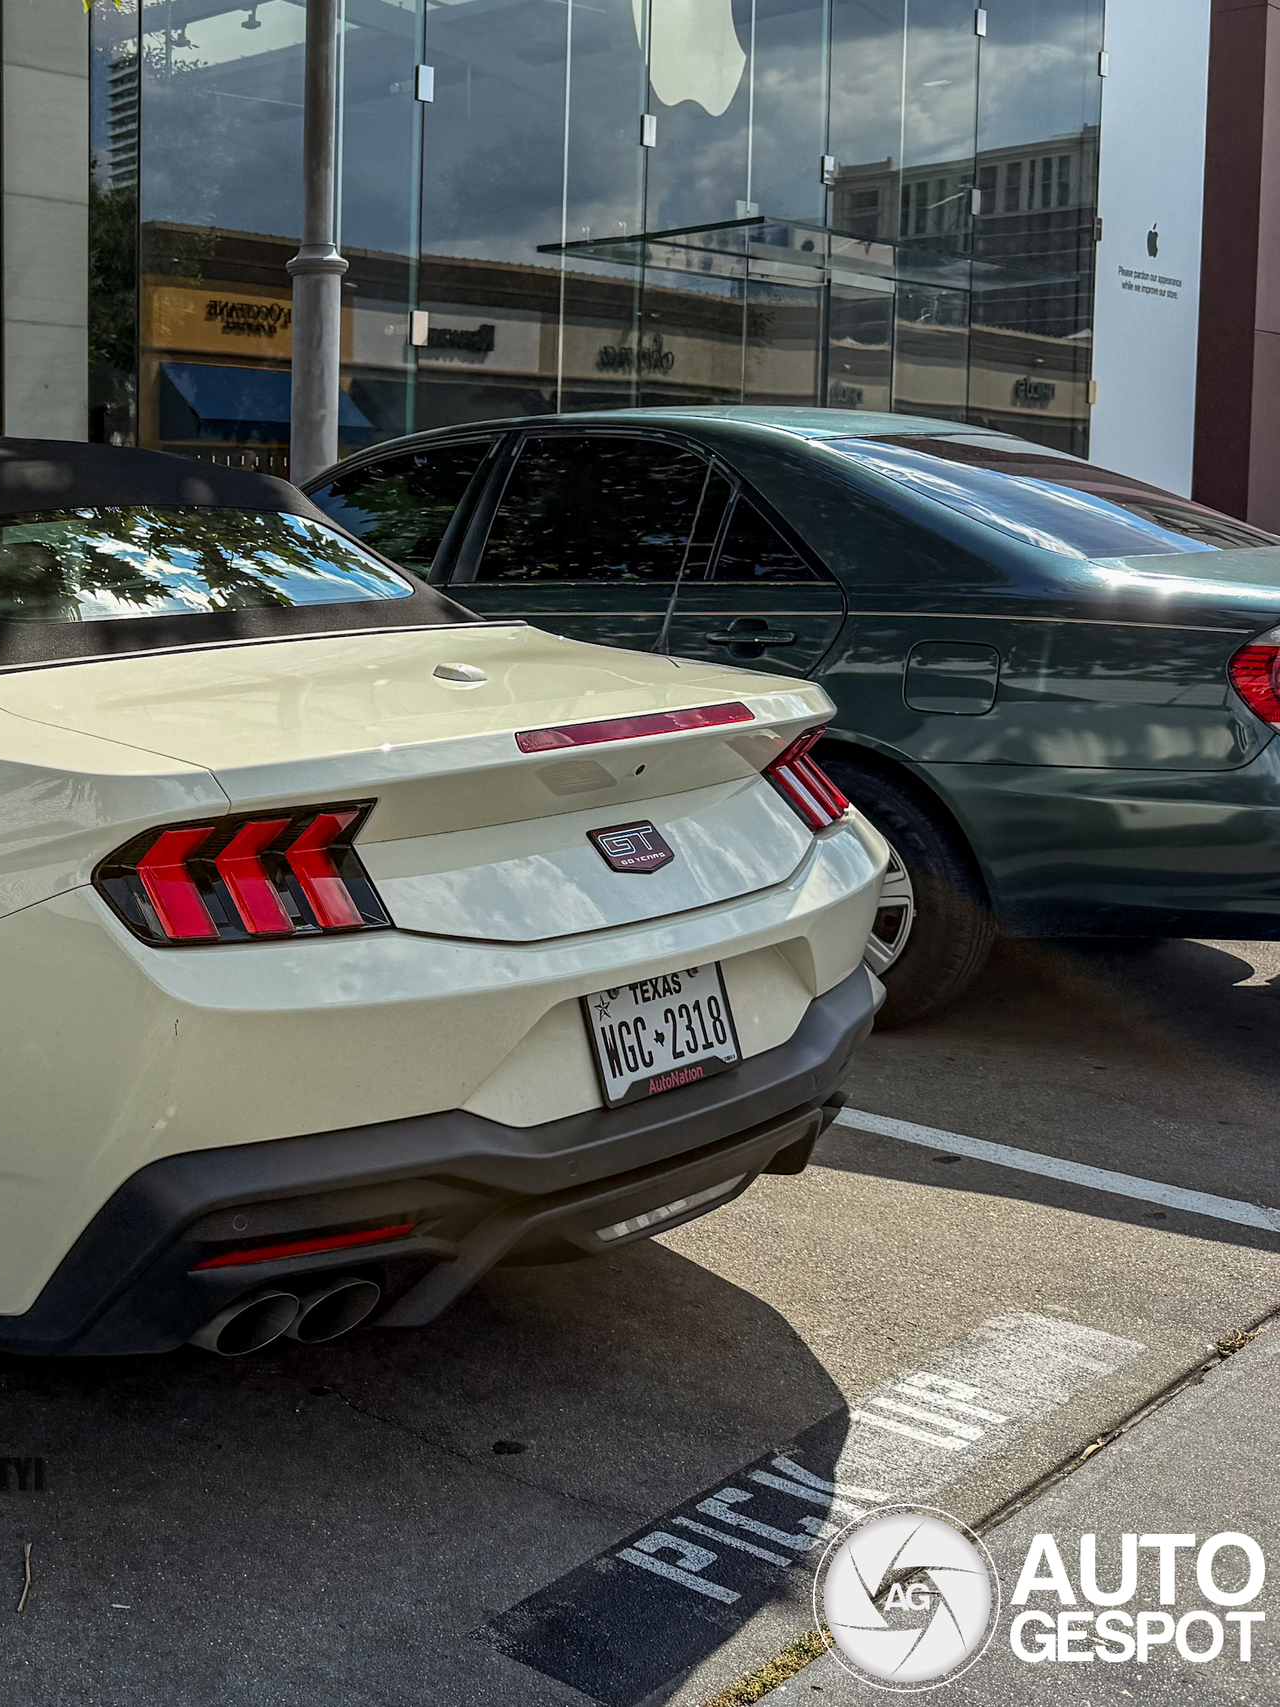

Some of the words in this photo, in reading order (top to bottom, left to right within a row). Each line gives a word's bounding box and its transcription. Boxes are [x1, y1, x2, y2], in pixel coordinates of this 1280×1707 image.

[1118, 265, 1133, 278] Please
[1134, 270, 1149, 280] pardon
[1158, 275, 1182, 288] appearance
[1122, 280, 1133, 291] while
[1134, 284, 1141, 292] we
[1141, 283, 1158, 295] improve
[597, 825, 653, 857] GT
[620, 858, 635, 866] 60
[635, 852, 666, 862] YEARS
[628, 972, 682, 1005] TEXAS
[600, 1016, 655, 1079] WGC
[663, 995, 728, 1060] 2318
[649, 1066, 704, 1095] AutoNation
[615, 1448, 892, 1605] PICK
[851, 1370, 1012, 1450] UP
